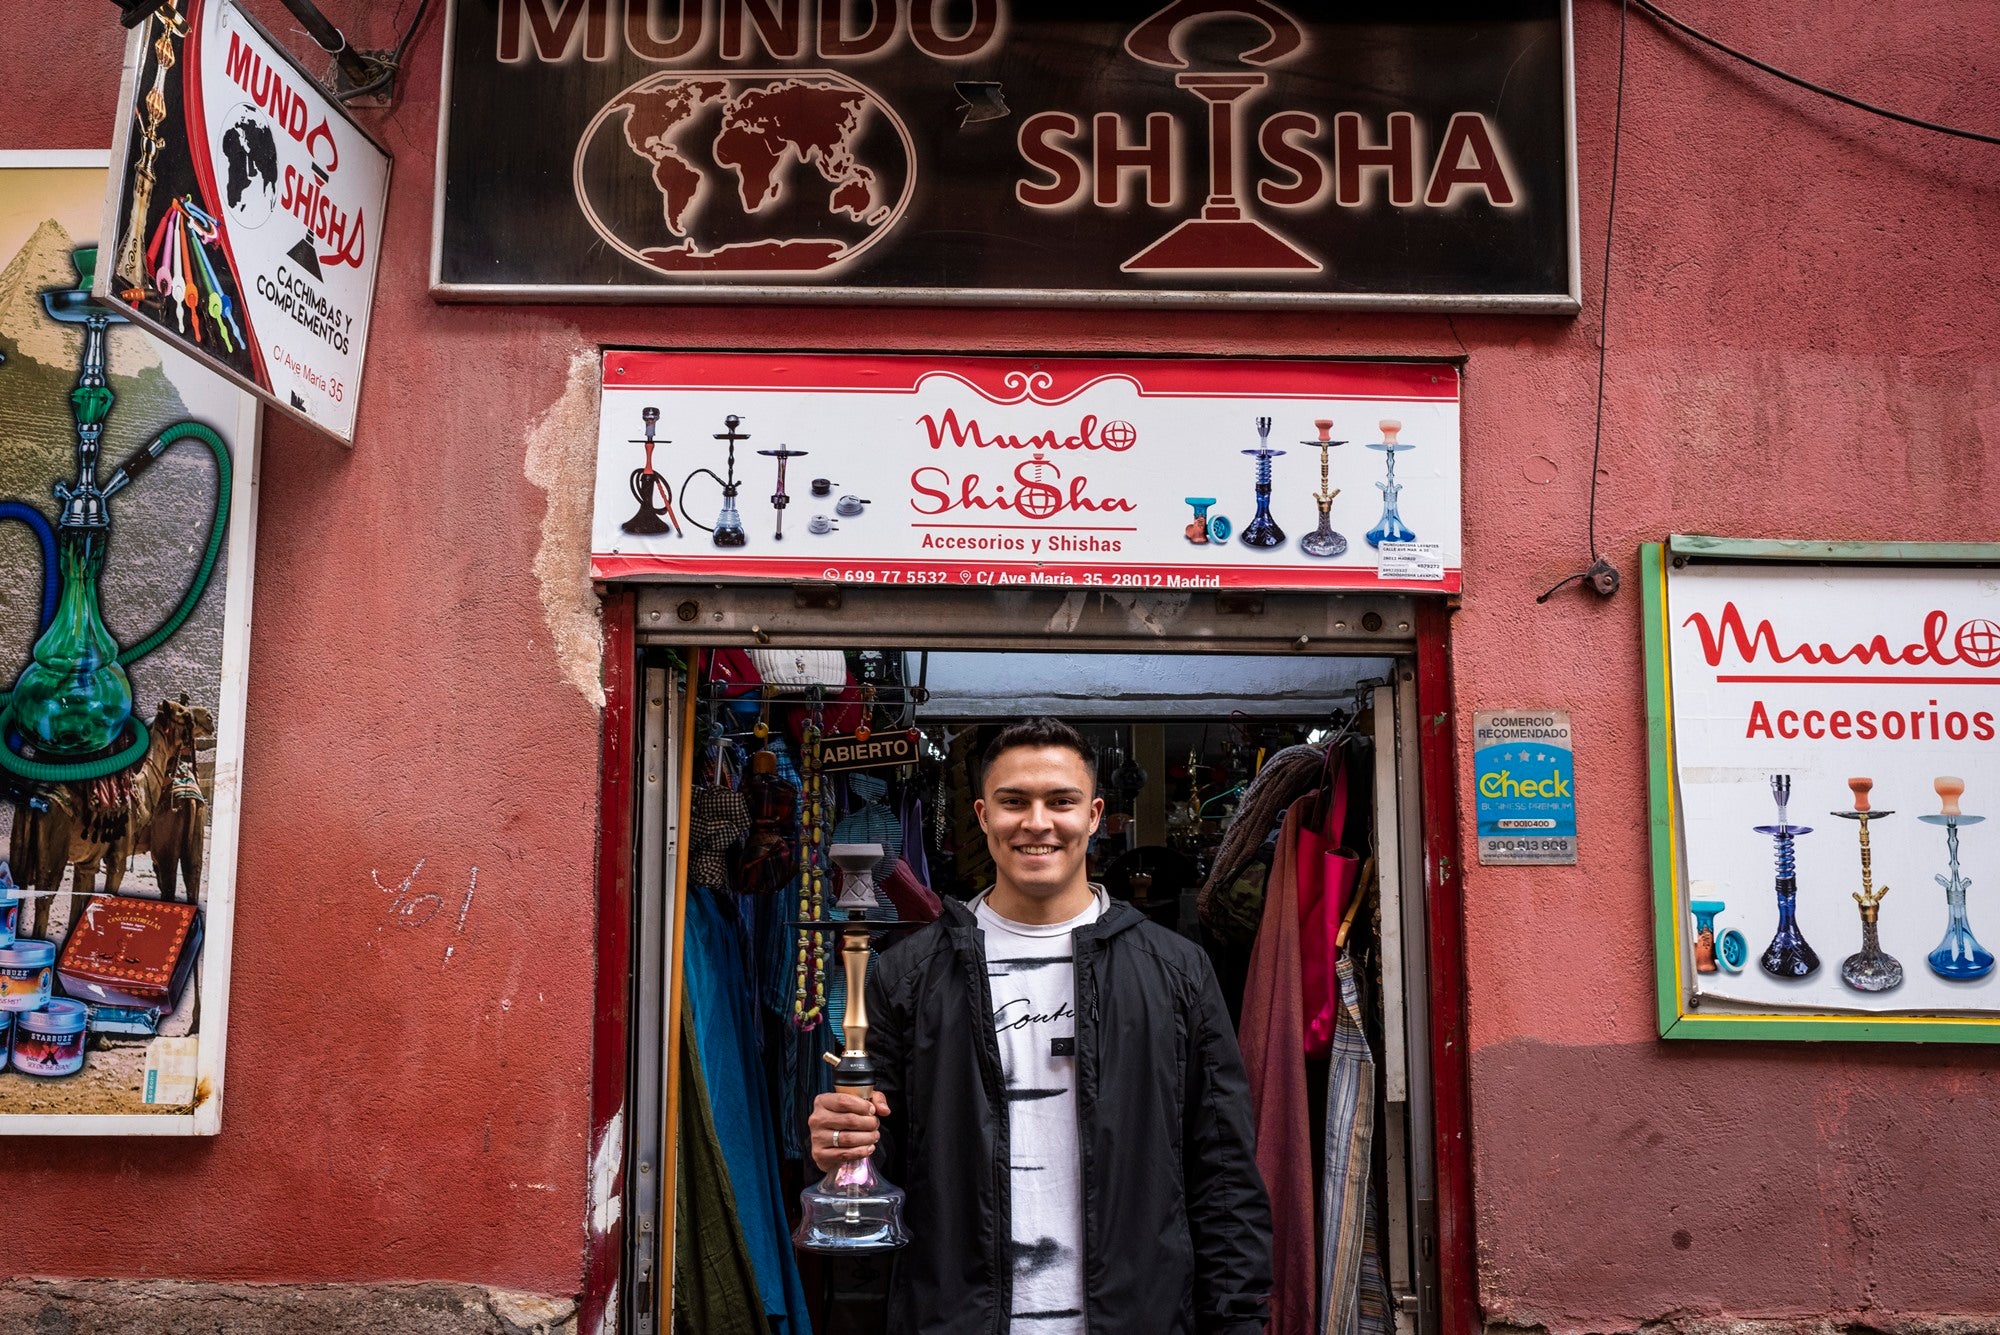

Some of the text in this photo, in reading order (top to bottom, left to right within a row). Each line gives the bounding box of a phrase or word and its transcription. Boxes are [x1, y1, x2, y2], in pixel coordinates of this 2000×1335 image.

[496, 0, 1002, 62] MUNDO
[225, 29, 339, 173] MUNDO
[1016, 110, 1518, 208] SHISHA
[281, 163, 365, 269] SHISHA
[256, 274, 350, 356] COMPLEMENTOS
[276, 265, 353, 335] CACHIMBAS Y
[273, 344, 284, 363] C/
[284, 353, 301, 375] Ave
[328, 378, 344, 402] 35
[915, 408, 1138, 452] Mundo
[921, 532, 1122, 555] Accesorios y Shishas
[844, 570, 875, 582] 699
[881, 570, 901, 583] 77
[906, 571, 947, 584] 5532
[976, 571, 994, 586] C/
[998, 571, 1026, 585] Ave
[1111, 573, 1162, 588] 28012
[1166, 574, 1221, 589] Madrid
[1681, 601, 2000, 668] Mundo
[1478, 728, 1569, 739] RECOMENDADO
[1491, 717, 1554, 727] COMERCIO
[1745, 699, 1996, 741] Accesorios
[822, 739, 909, 764] ABIERTO
[1479, 769, 1571, 799] Check
[1513, 820, 1550, 828] 0010400
[1488, 840, 1568, 851] 900 813 808
[129, 916, 162, 931] ESTRELLAS
[31, 1033, 73, 1043] STARBUZZ
